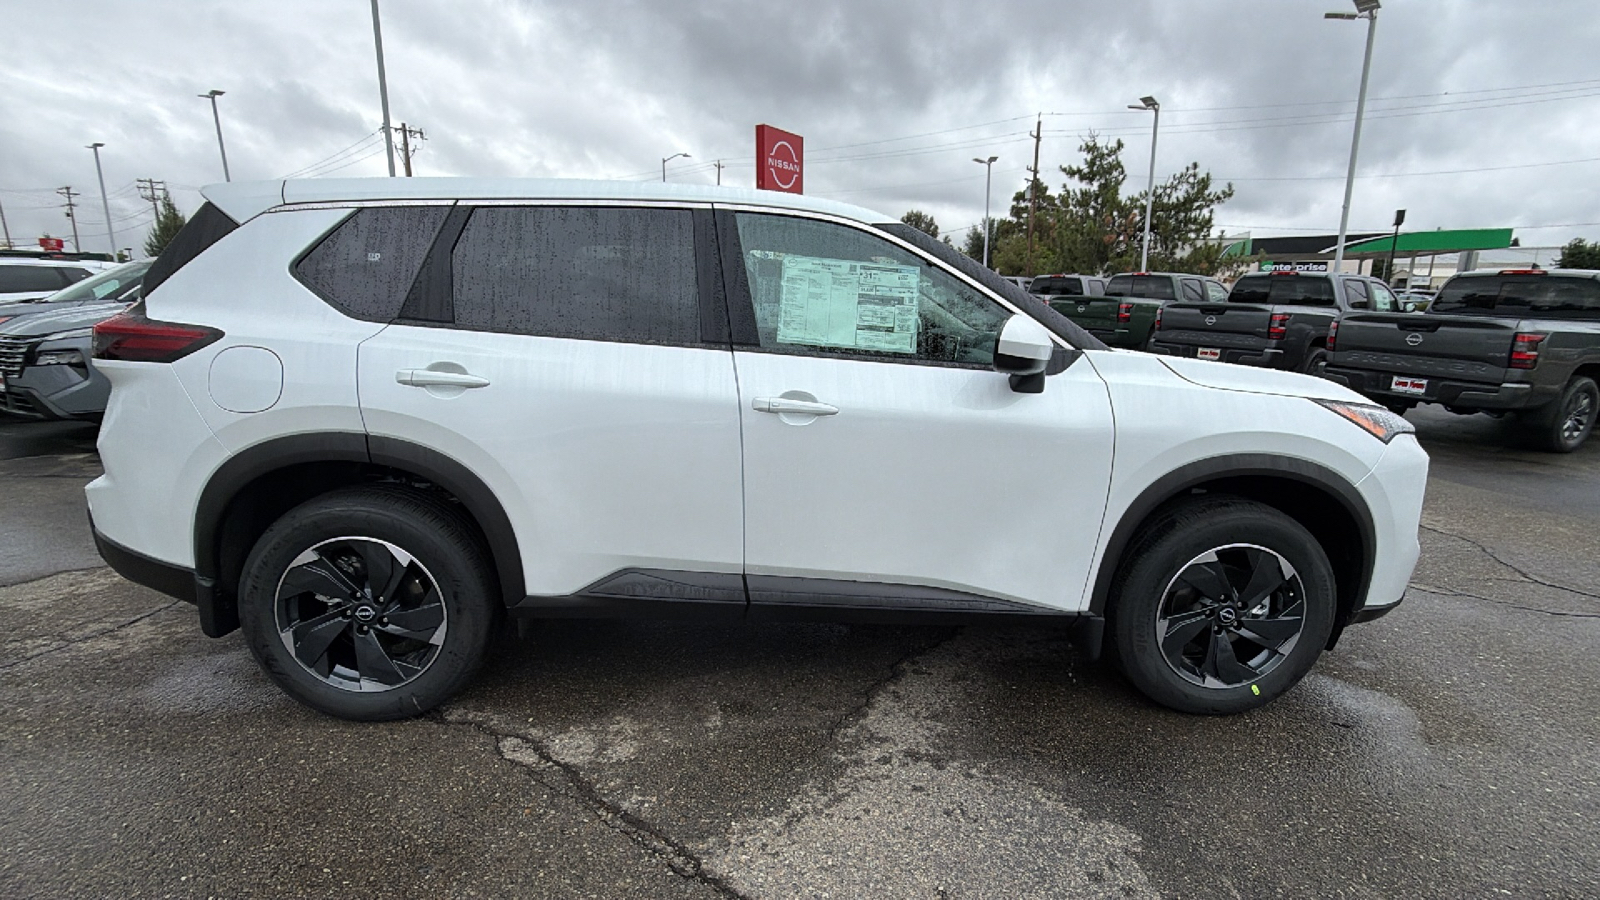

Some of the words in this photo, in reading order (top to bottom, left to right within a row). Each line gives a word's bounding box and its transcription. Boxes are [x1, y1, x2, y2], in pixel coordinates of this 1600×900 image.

[768, 157, 800, 173] NISSAN
[1261, 262, 1327, 272] enteprise
[1346, 353, 1487, 374] FRONTIER
